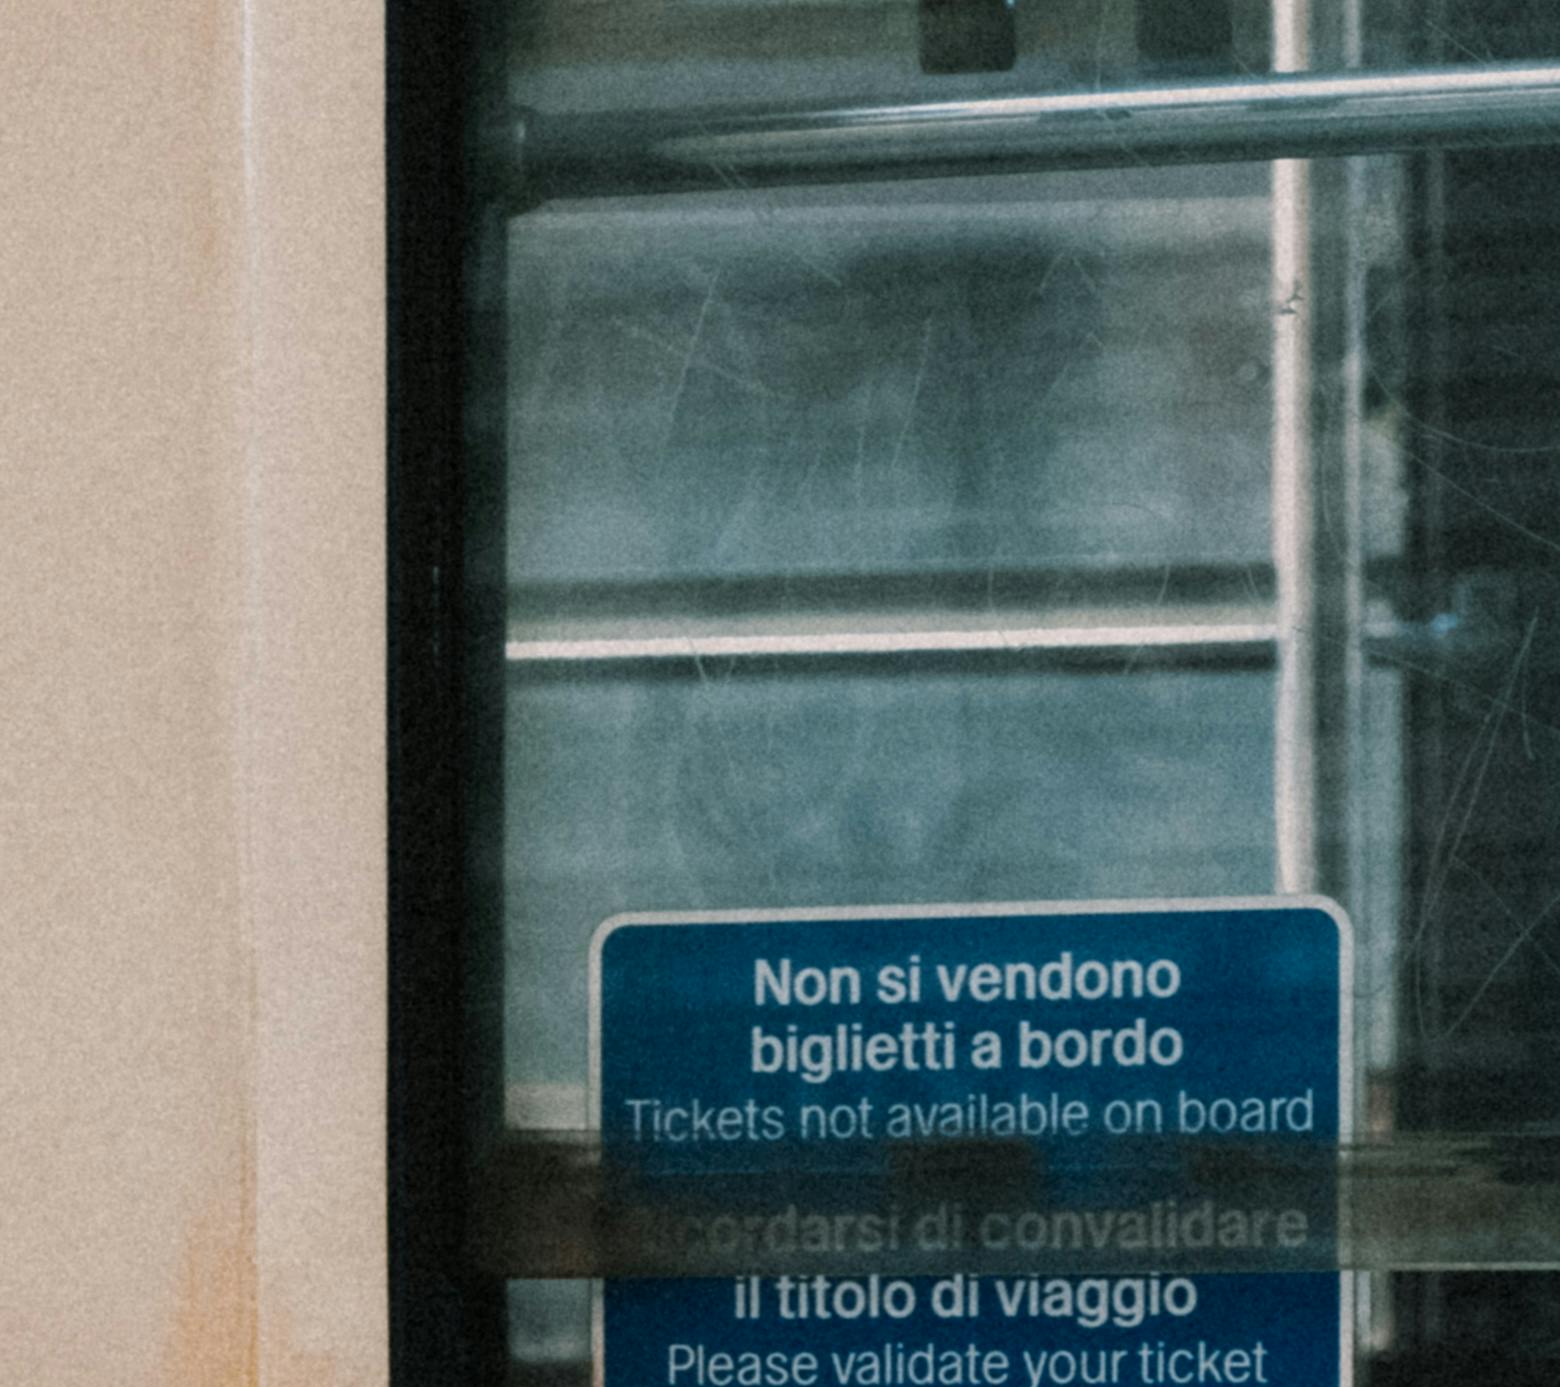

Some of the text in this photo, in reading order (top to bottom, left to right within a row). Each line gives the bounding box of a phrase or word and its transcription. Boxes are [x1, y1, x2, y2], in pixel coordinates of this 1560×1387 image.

[755, 952, 1180, 1005] Non si vendono
[752, 1018, 1183, 1083] biglietti a bordo
[626, 1089, 1313, 1143] Tickets not available on board
[629, 1201, 1308, 1256] cordarsi di convalidare
[735, 1272, 1197, 1327] il titolo di viaggio
[668, 1344, 818, 1386] Please
[832, 1344, 1009, 1385] validate
[1139, 1342, 1266, 1383] ticket
